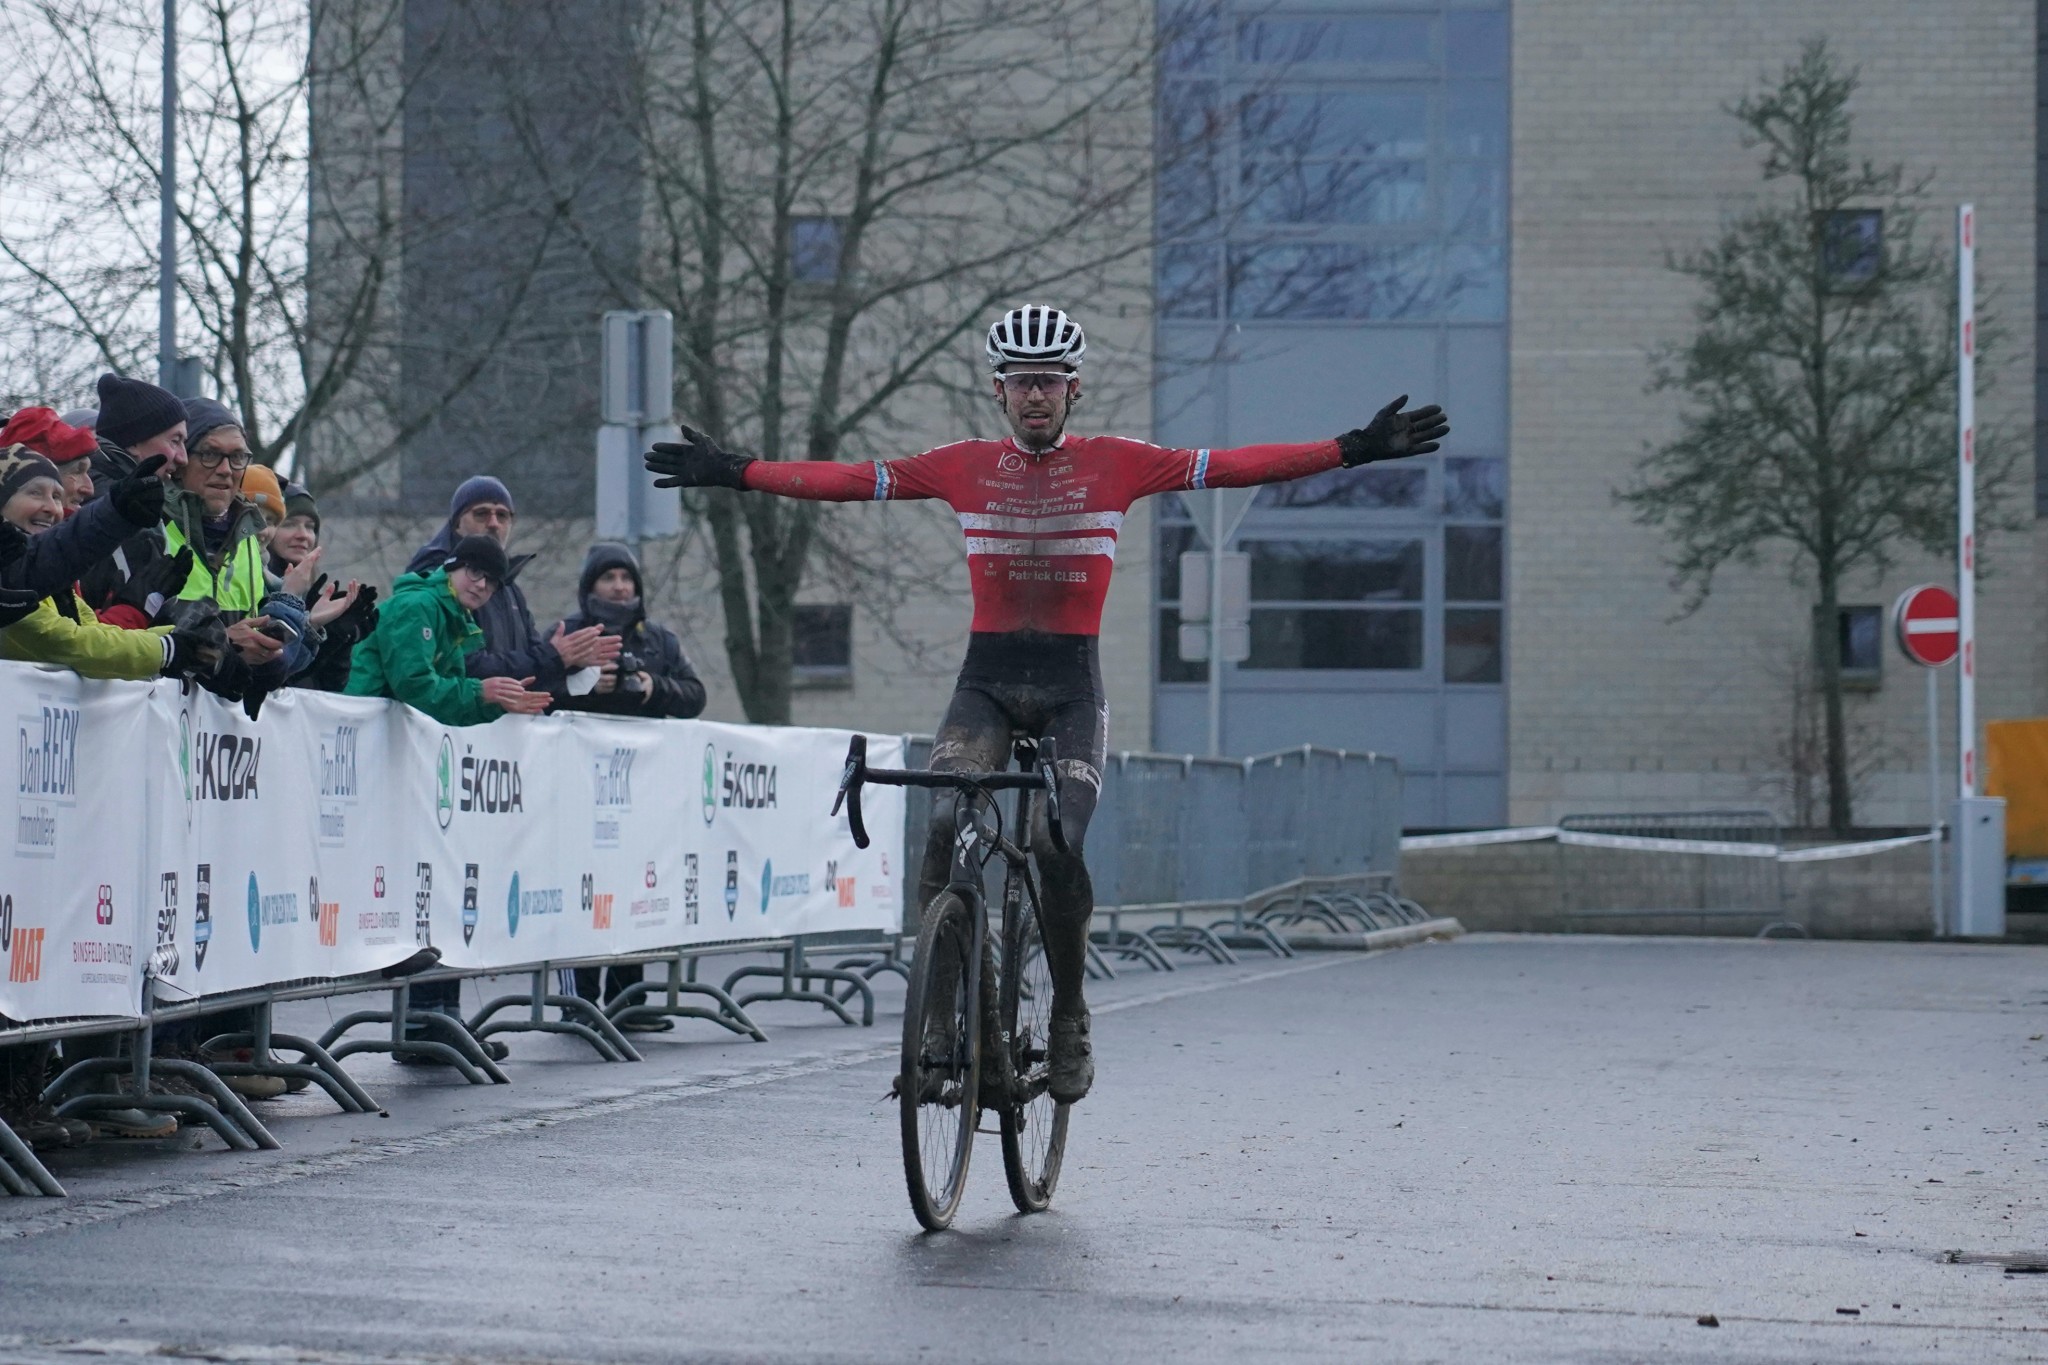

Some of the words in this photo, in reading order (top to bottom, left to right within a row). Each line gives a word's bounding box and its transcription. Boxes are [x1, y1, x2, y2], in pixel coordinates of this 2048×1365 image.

[1008, 570, 1051, 582] Patrick
[1055, 571, 1087, 583] CLEES
[1009, 559, 1051, 568] AGENCE
[460, 744, 523, 814] ŠKODA
[722, 751, 777, 810] ŠKODA
[9, 927, 45, 983] MAT
[73, 941, 103, 963] BINSFELD
